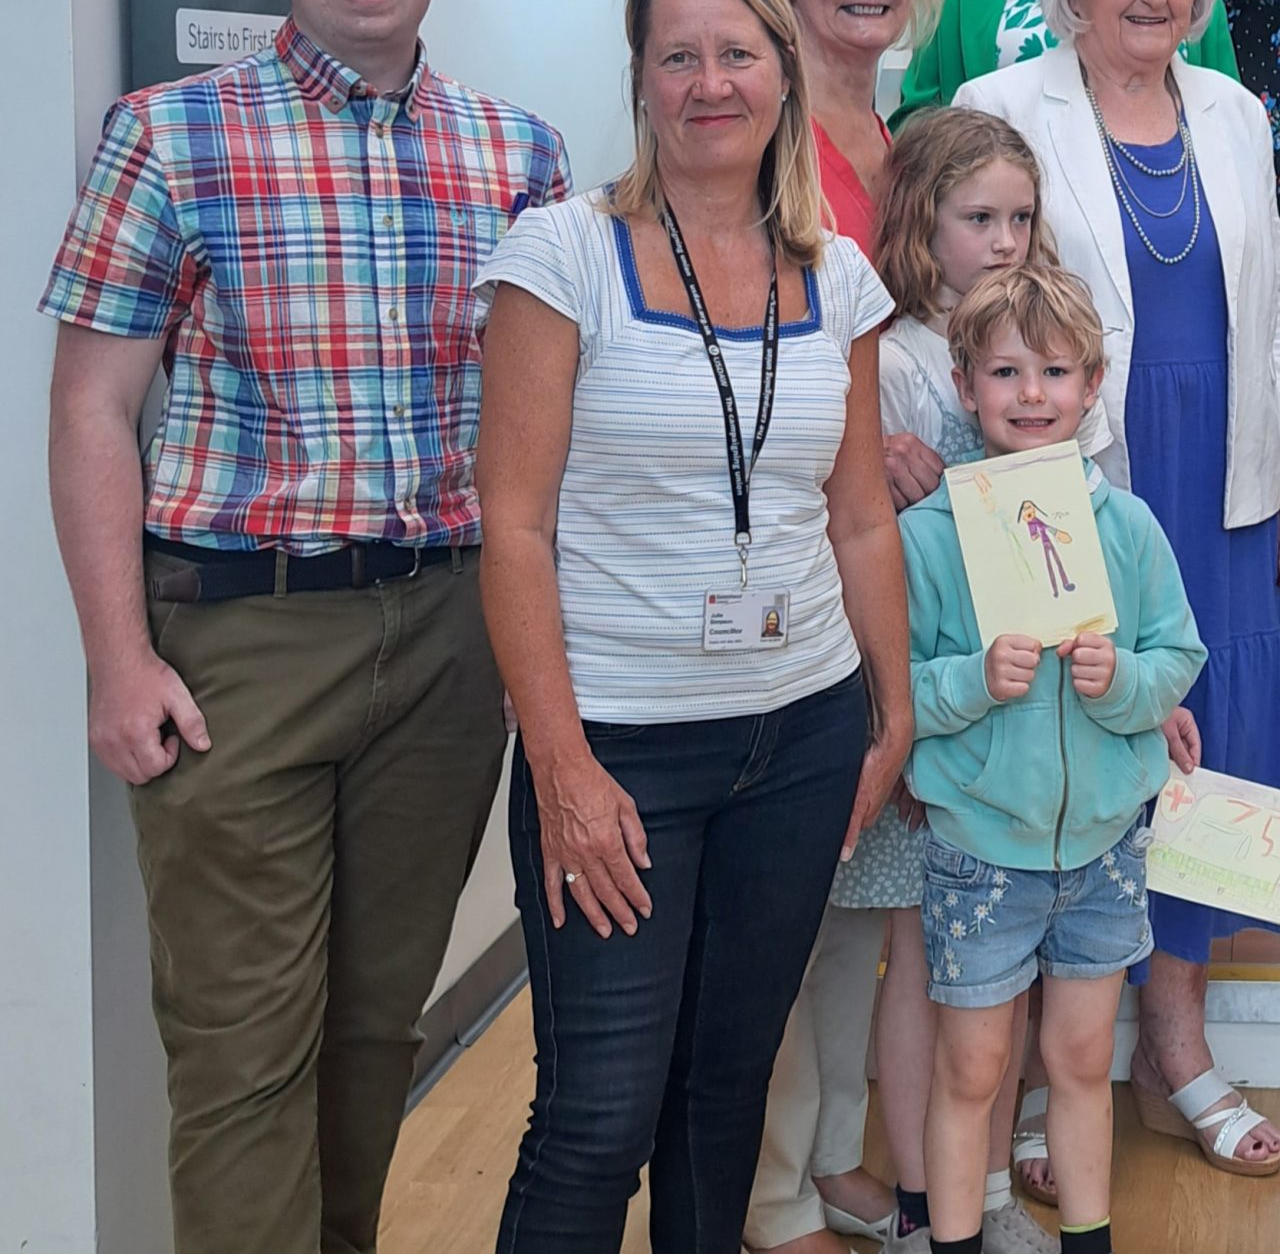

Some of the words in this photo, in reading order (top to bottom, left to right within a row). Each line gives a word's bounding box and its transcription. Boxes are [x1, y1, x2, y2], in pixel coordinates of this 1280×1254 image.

[188, 22, 225, 50] Stairs
[227, 27, 240, 50] to
[242, 27, 267, 52] First
[680, 254, 691, 277] union
[765, 348, 773, 370] union
[713, 357, 728, 387] USDAW
[725, 396, 733, 413] The
[760, 371, 774, 424] campaigning
[728, 414, 742, 470] campaigning
[756, 425, 765, 440] The
[733, 471, 743, 496] union
